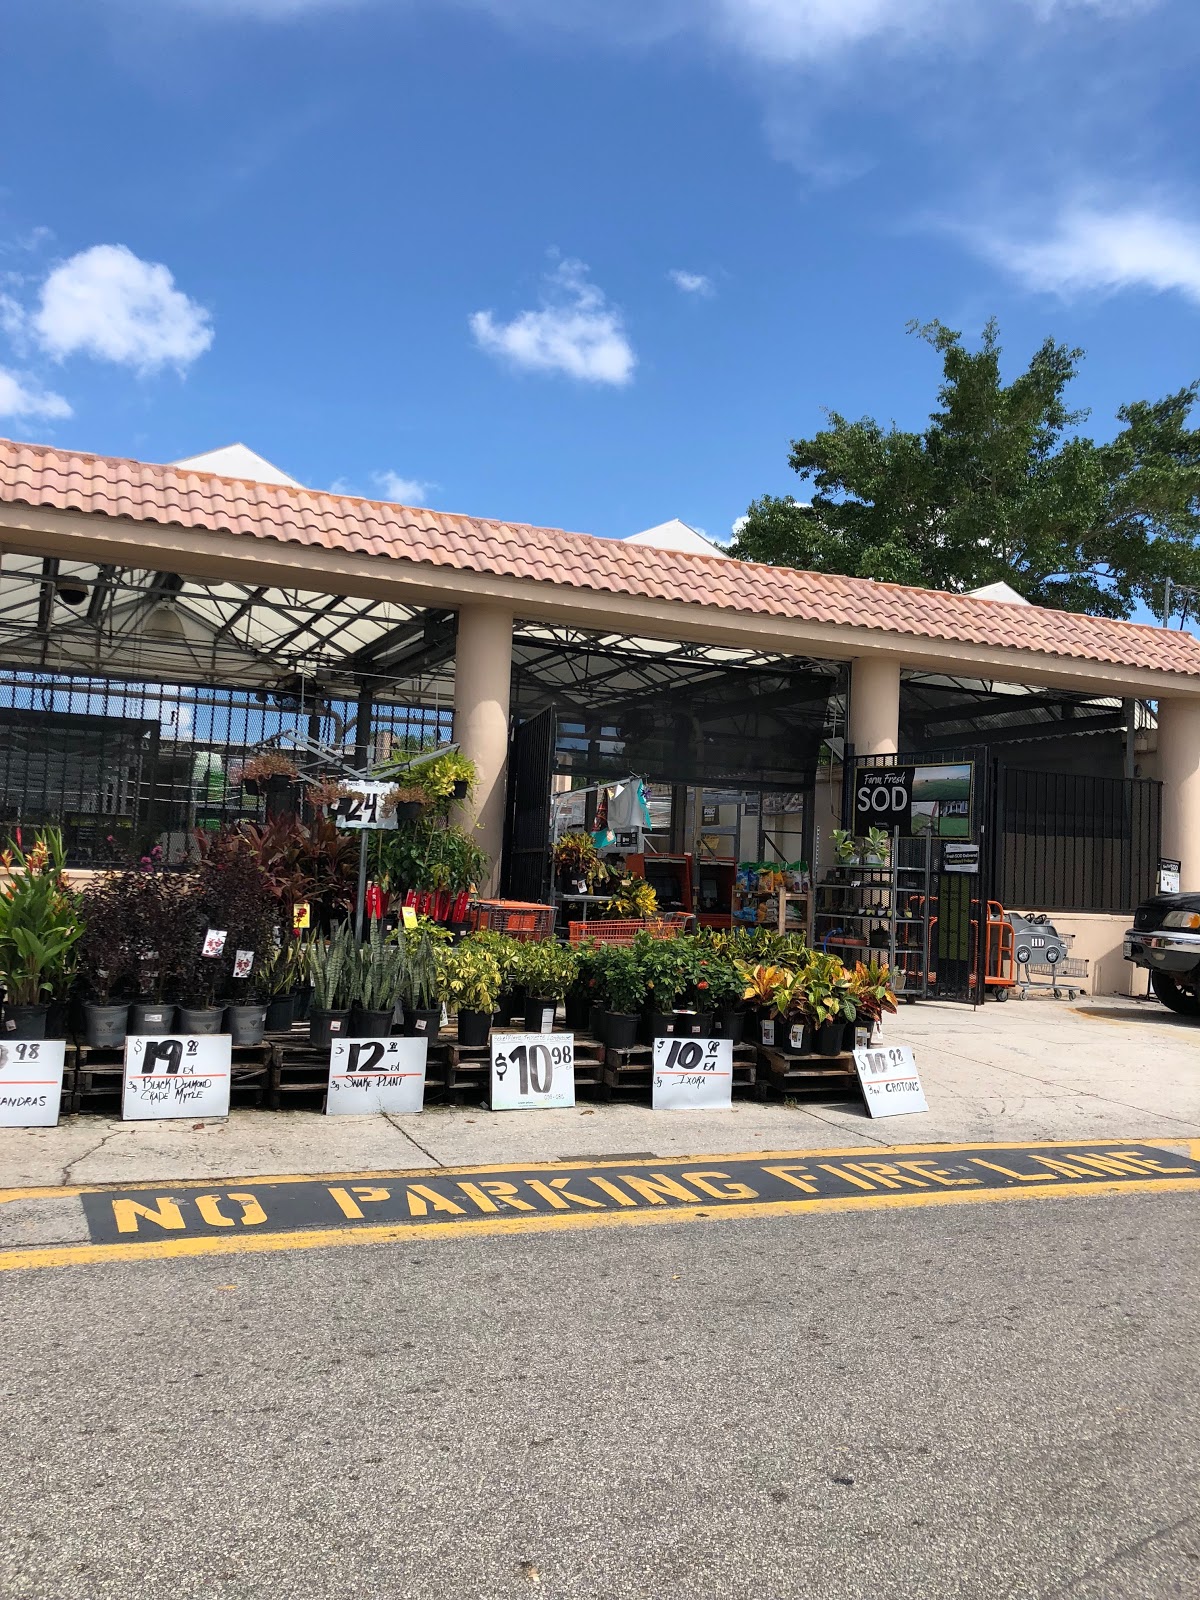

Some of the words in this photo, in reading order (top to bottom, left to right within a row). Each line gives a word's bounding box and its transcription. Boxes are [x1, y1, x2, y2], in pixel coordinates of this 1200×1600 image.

[884, 771, 906, 785] Fresh
[857, 786, 908, 812] SOD
[15, 1043, 41, 1061] 98
[551, 1045, 572, 1065] 98
[885, 1081, 920, 1093] CROTONS
[0, 1095, 47, 1108] ANDRAS
[111, 1193, 268, 1233] NO
[327, 1171, 760, 1219] PARKING
[760, 1160, 984, 1193] FIRE
[966, 1151, 1197, 1181] LANE
